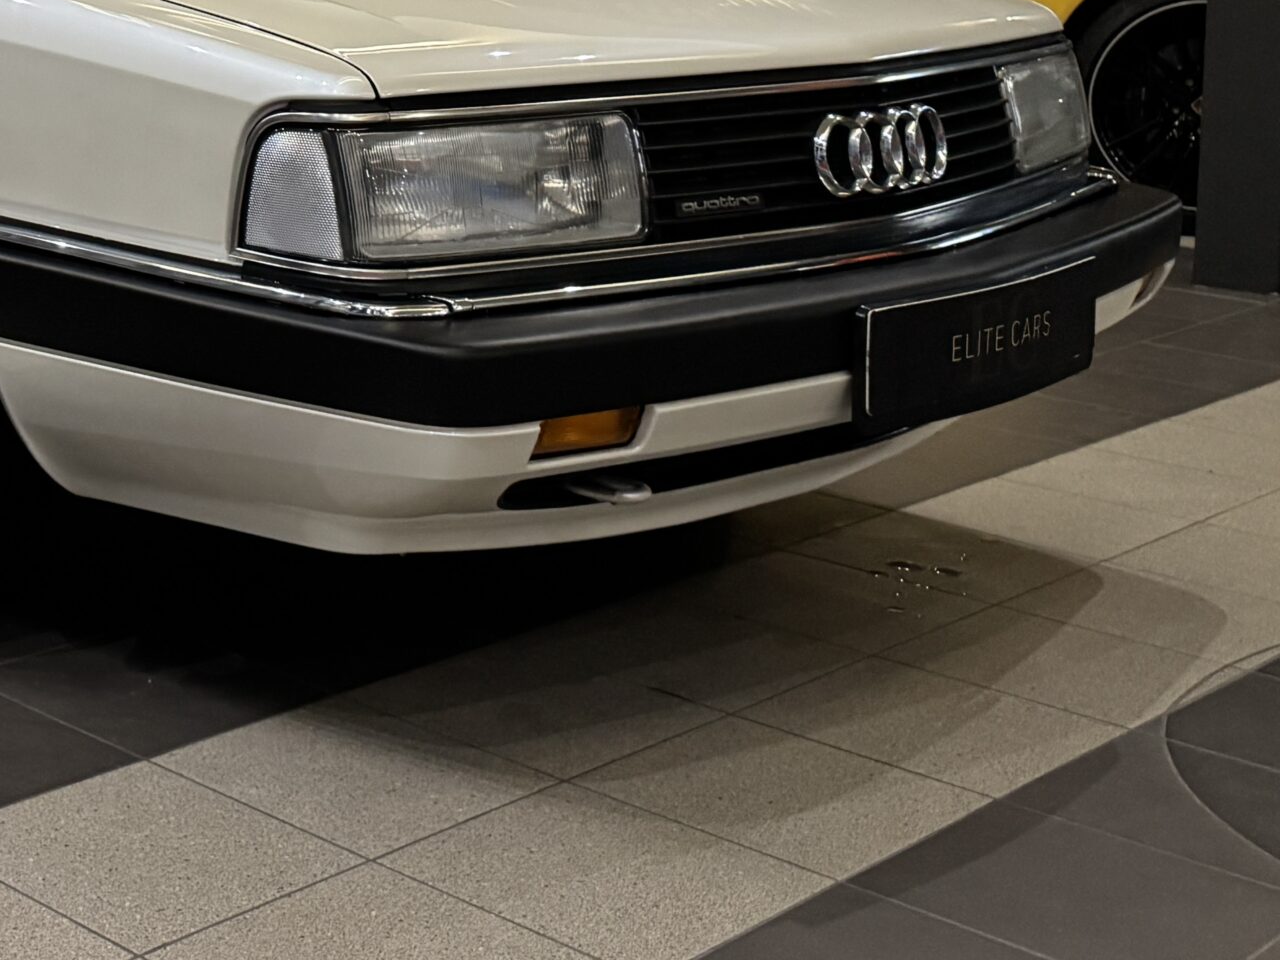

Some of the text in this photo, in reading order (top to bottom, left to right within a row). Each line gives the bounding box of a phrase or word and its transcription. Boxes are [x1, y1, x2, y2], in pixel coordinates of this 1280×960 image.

[681, 195, 760, 213] quattro
[951, 310, 1051, 362] ELITE CARS
